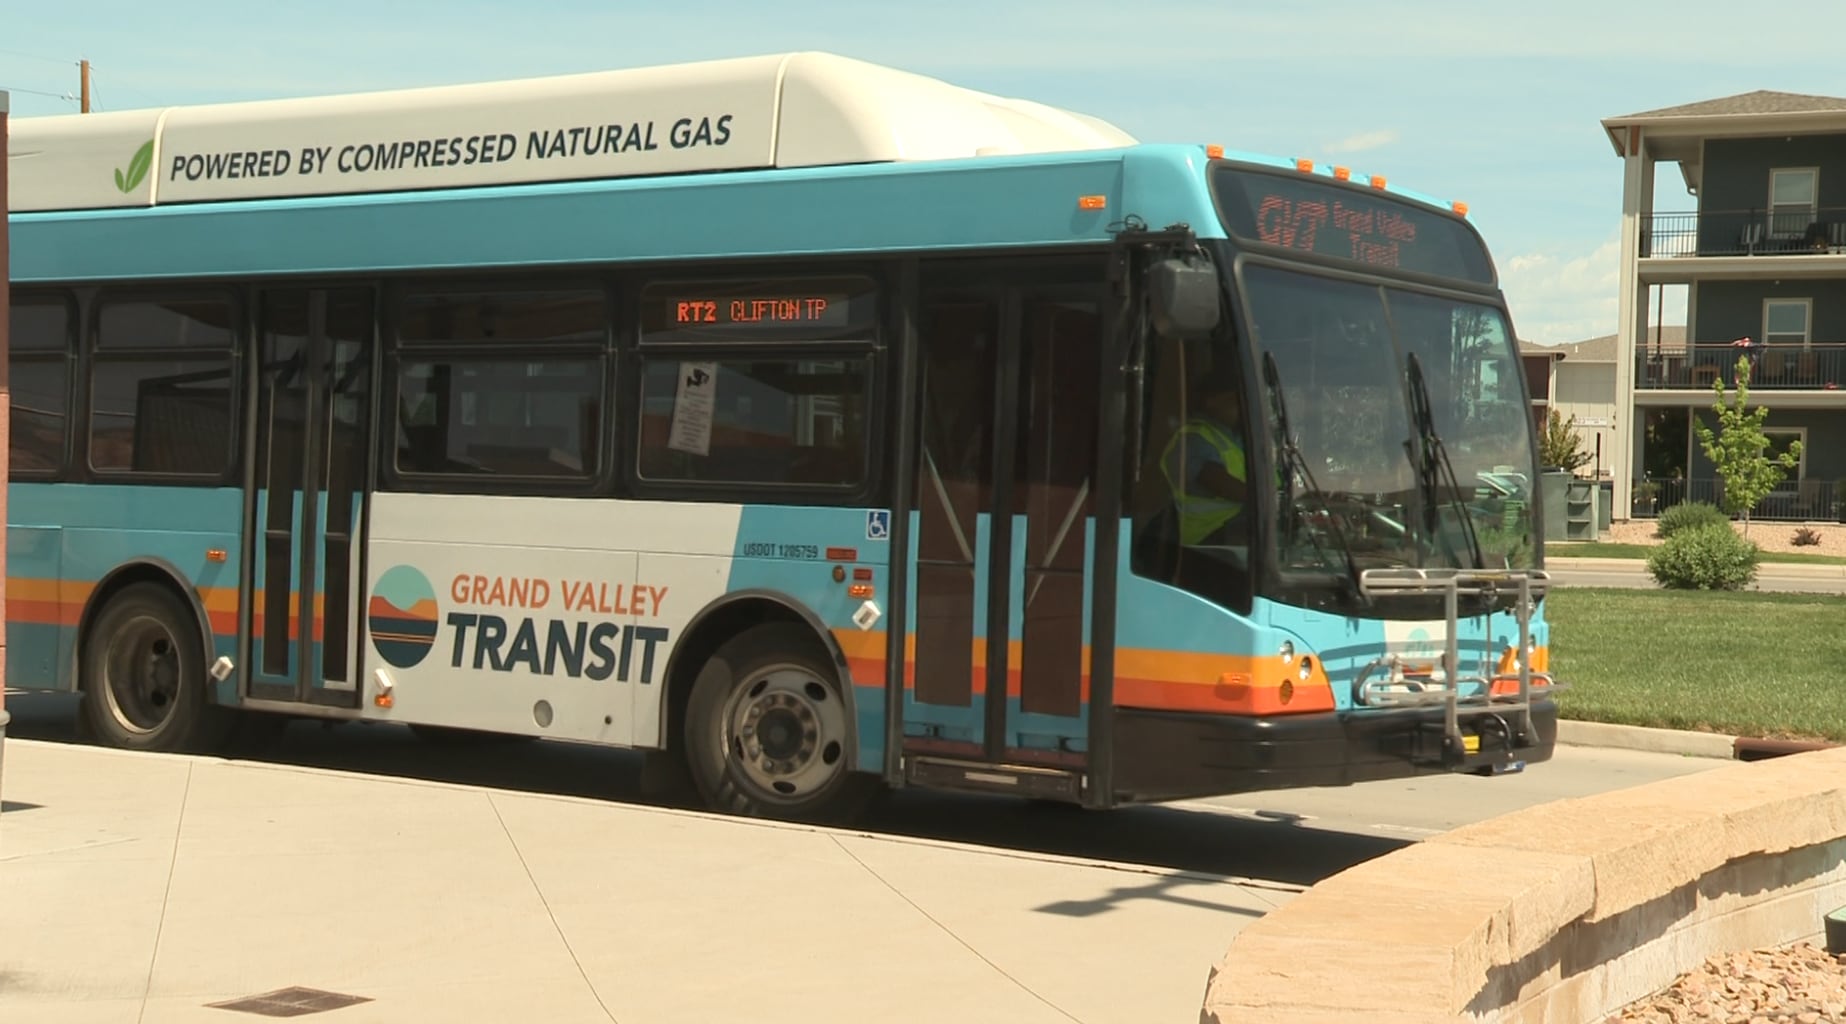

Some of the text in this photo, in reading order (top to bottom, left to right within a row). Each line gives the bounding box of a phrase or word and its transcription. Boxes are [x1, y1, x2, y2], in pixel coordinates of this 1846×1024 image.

[170, 114, 733, 182] POWERED BY COMPRESSED NATURAL GAS
[677, 299, 826, 322] RT2 CLIFTON TP
[743, 543, 776, 556] USDOT
[451, 574, 668, 617] GRAND VALLEY
[446, 612, 669, 684] TRANSIT
